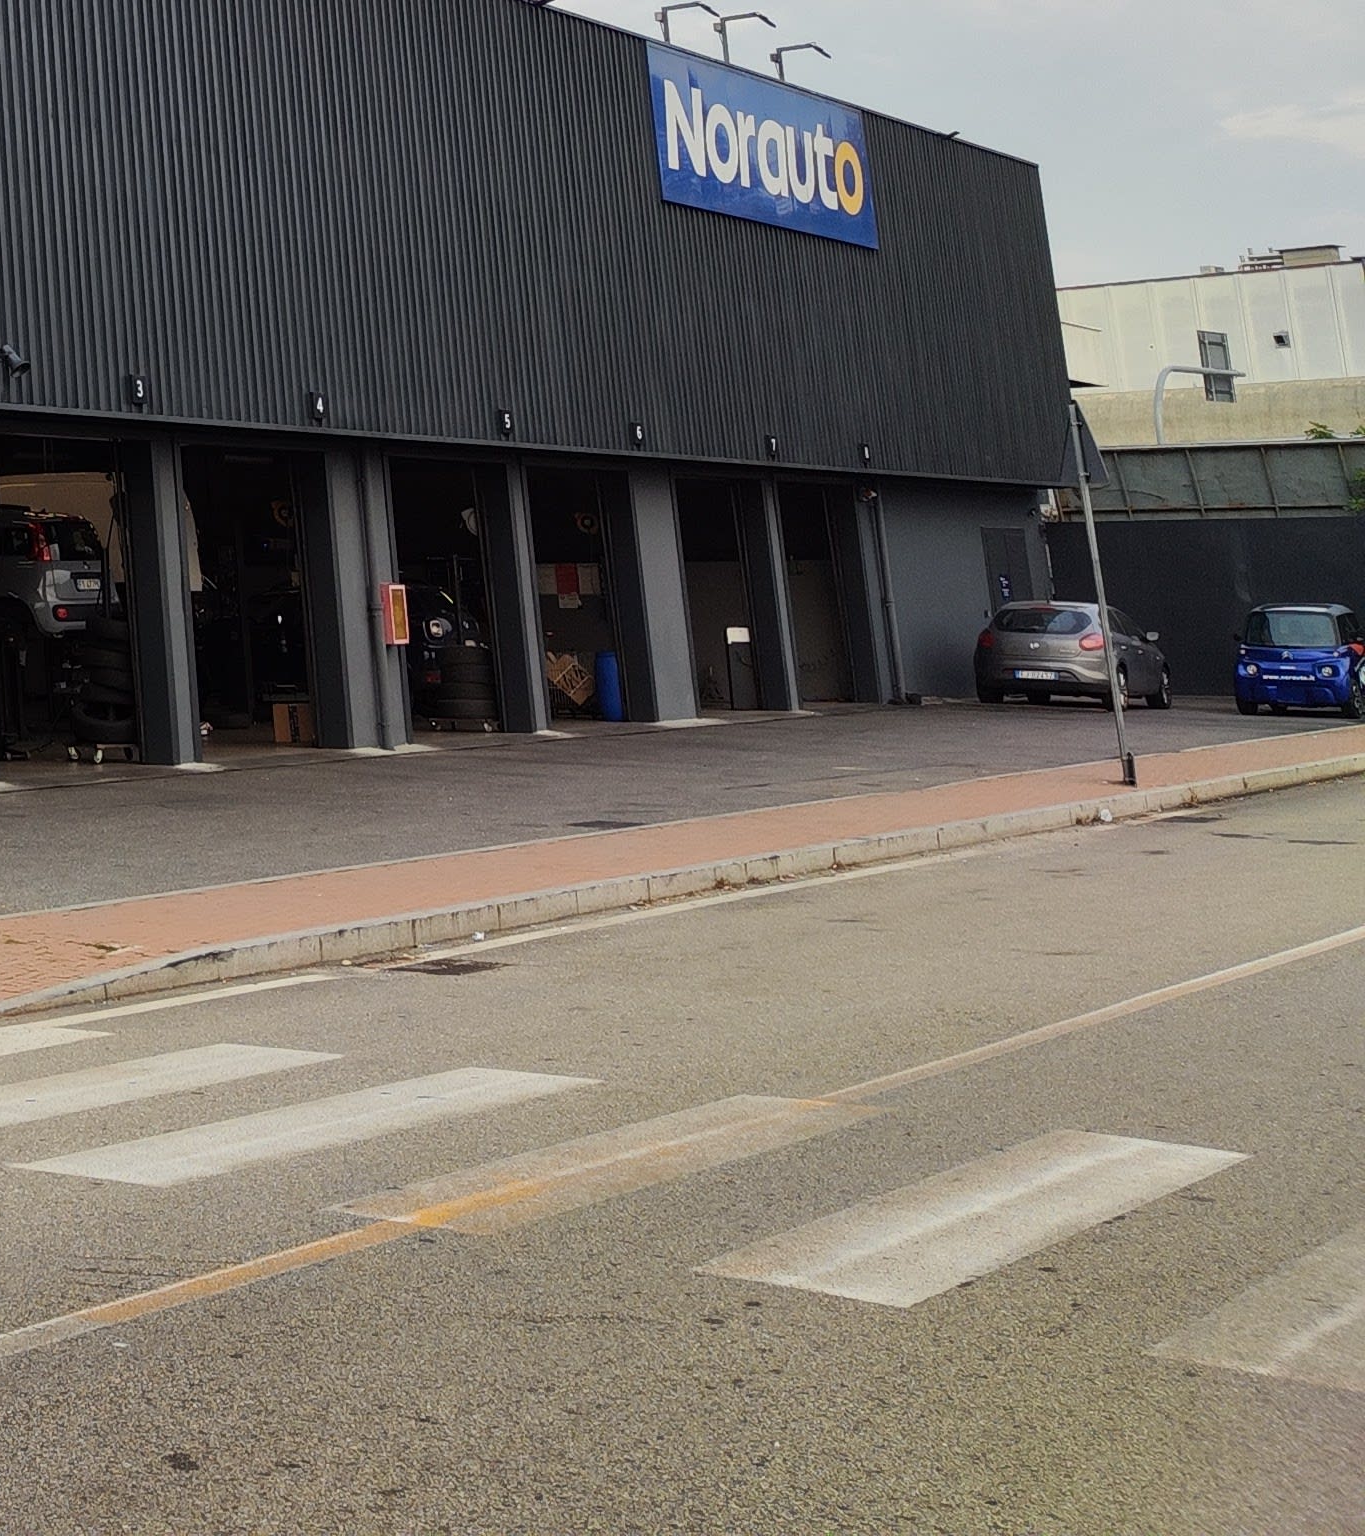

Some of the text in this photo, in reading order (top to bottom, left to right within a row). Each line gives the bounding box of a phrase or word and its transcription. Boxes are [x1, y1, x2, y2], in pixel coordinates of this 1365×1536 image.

[663, 78, 865, 216] Norauto
[136, 379, 144, 398] 3
[316, 397, 324, 413] 4
[504, 413, 511, 429] 5
[636, 425, 643, 440] 6
